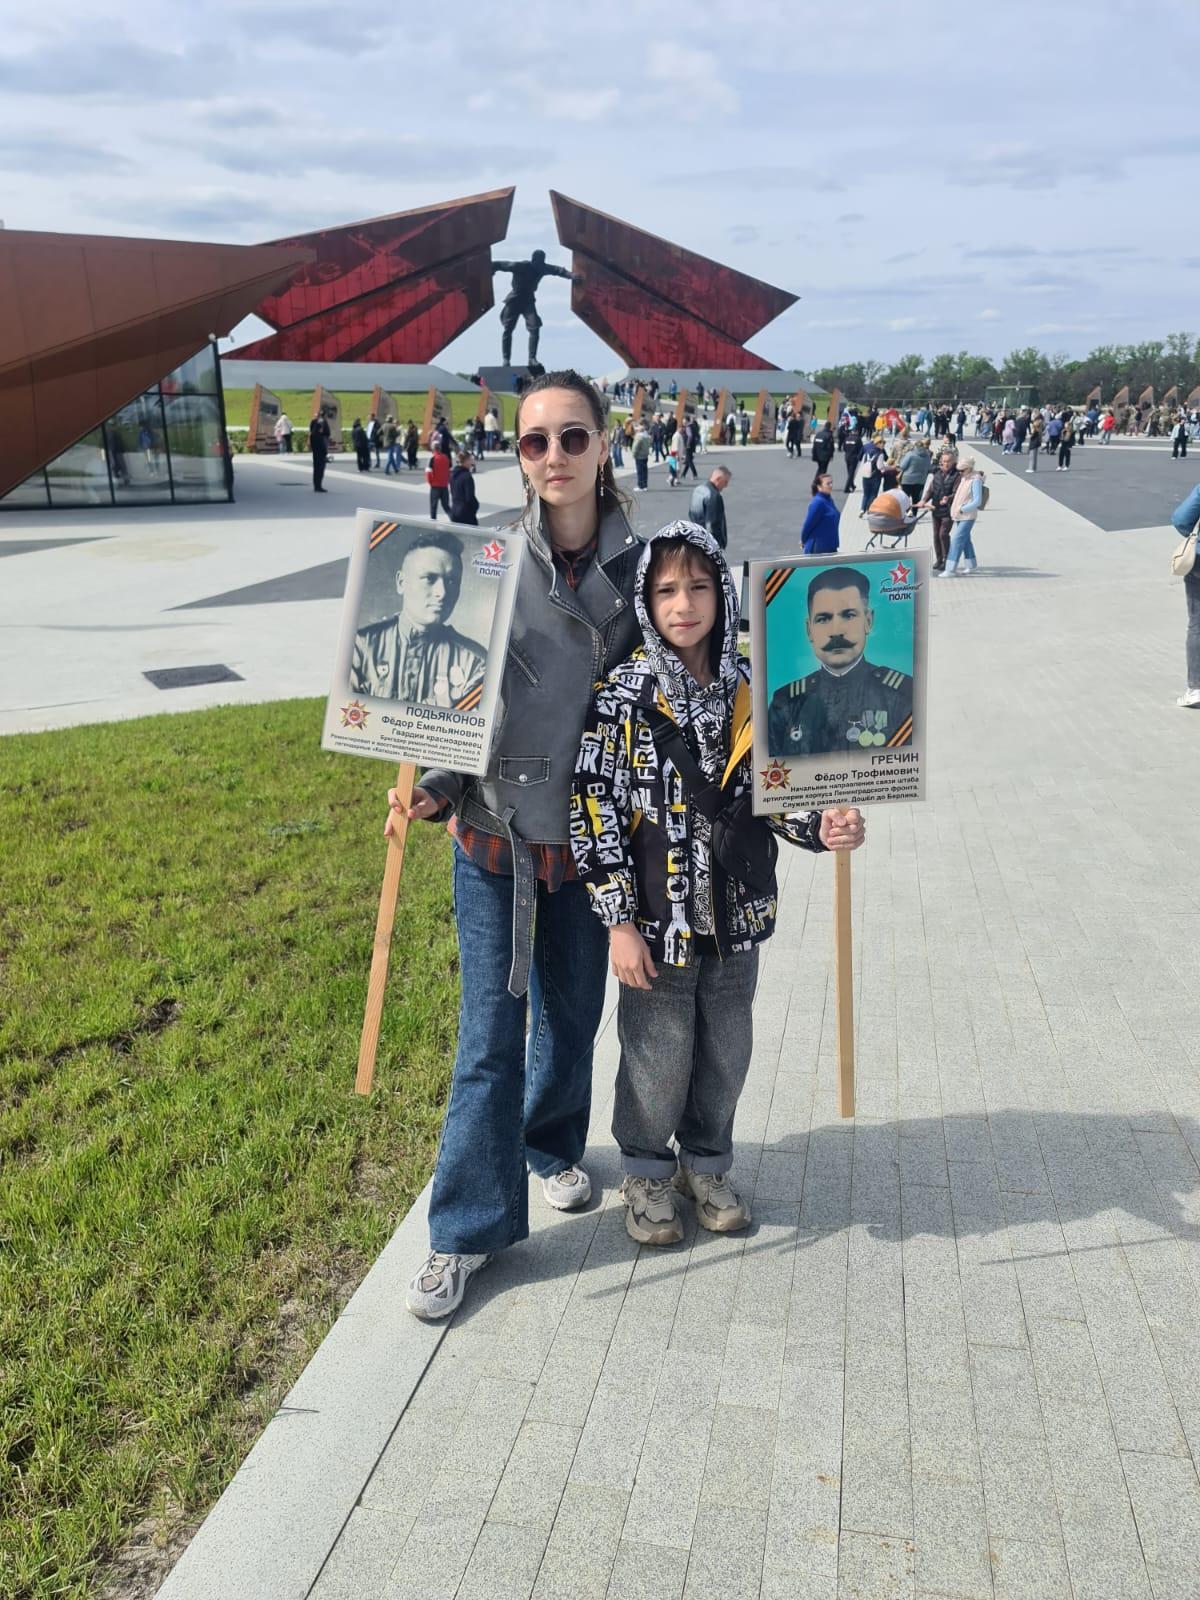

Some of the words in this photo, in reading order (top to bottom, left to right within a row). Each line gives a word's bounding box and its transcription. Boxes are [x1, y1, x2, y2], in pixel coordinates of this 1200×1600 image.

[479, 567, 501, 577] ПОЛК
[889, 593, 912, 601] ПОЛК
[406, 706, 486, 728] ПОДЬЯКОНОВ
[381, 716, 414, 730] Фёдор
[416, 722, 484, 739] Емельянович
[392, 728, 425, 740] Гвардии
[426, 734, 482, 749] красноармеец
[871, 752, 919, 765] ГРЕЧИН
[814, 772, 849, 783] Фёдор
[851, 767, 919, 780] Трофимович
[790, 784, 828, 792] Начальник
[897, 776, 919, 784] штаба
[762, 793, 804, 803] артиллерии
[805, 791, 833, 800] корпуса
[834, 787, 889, 796] Ленинградского
[782, 801, 810, 809] Служил
[851, 795, 876, 803] Дошёл
